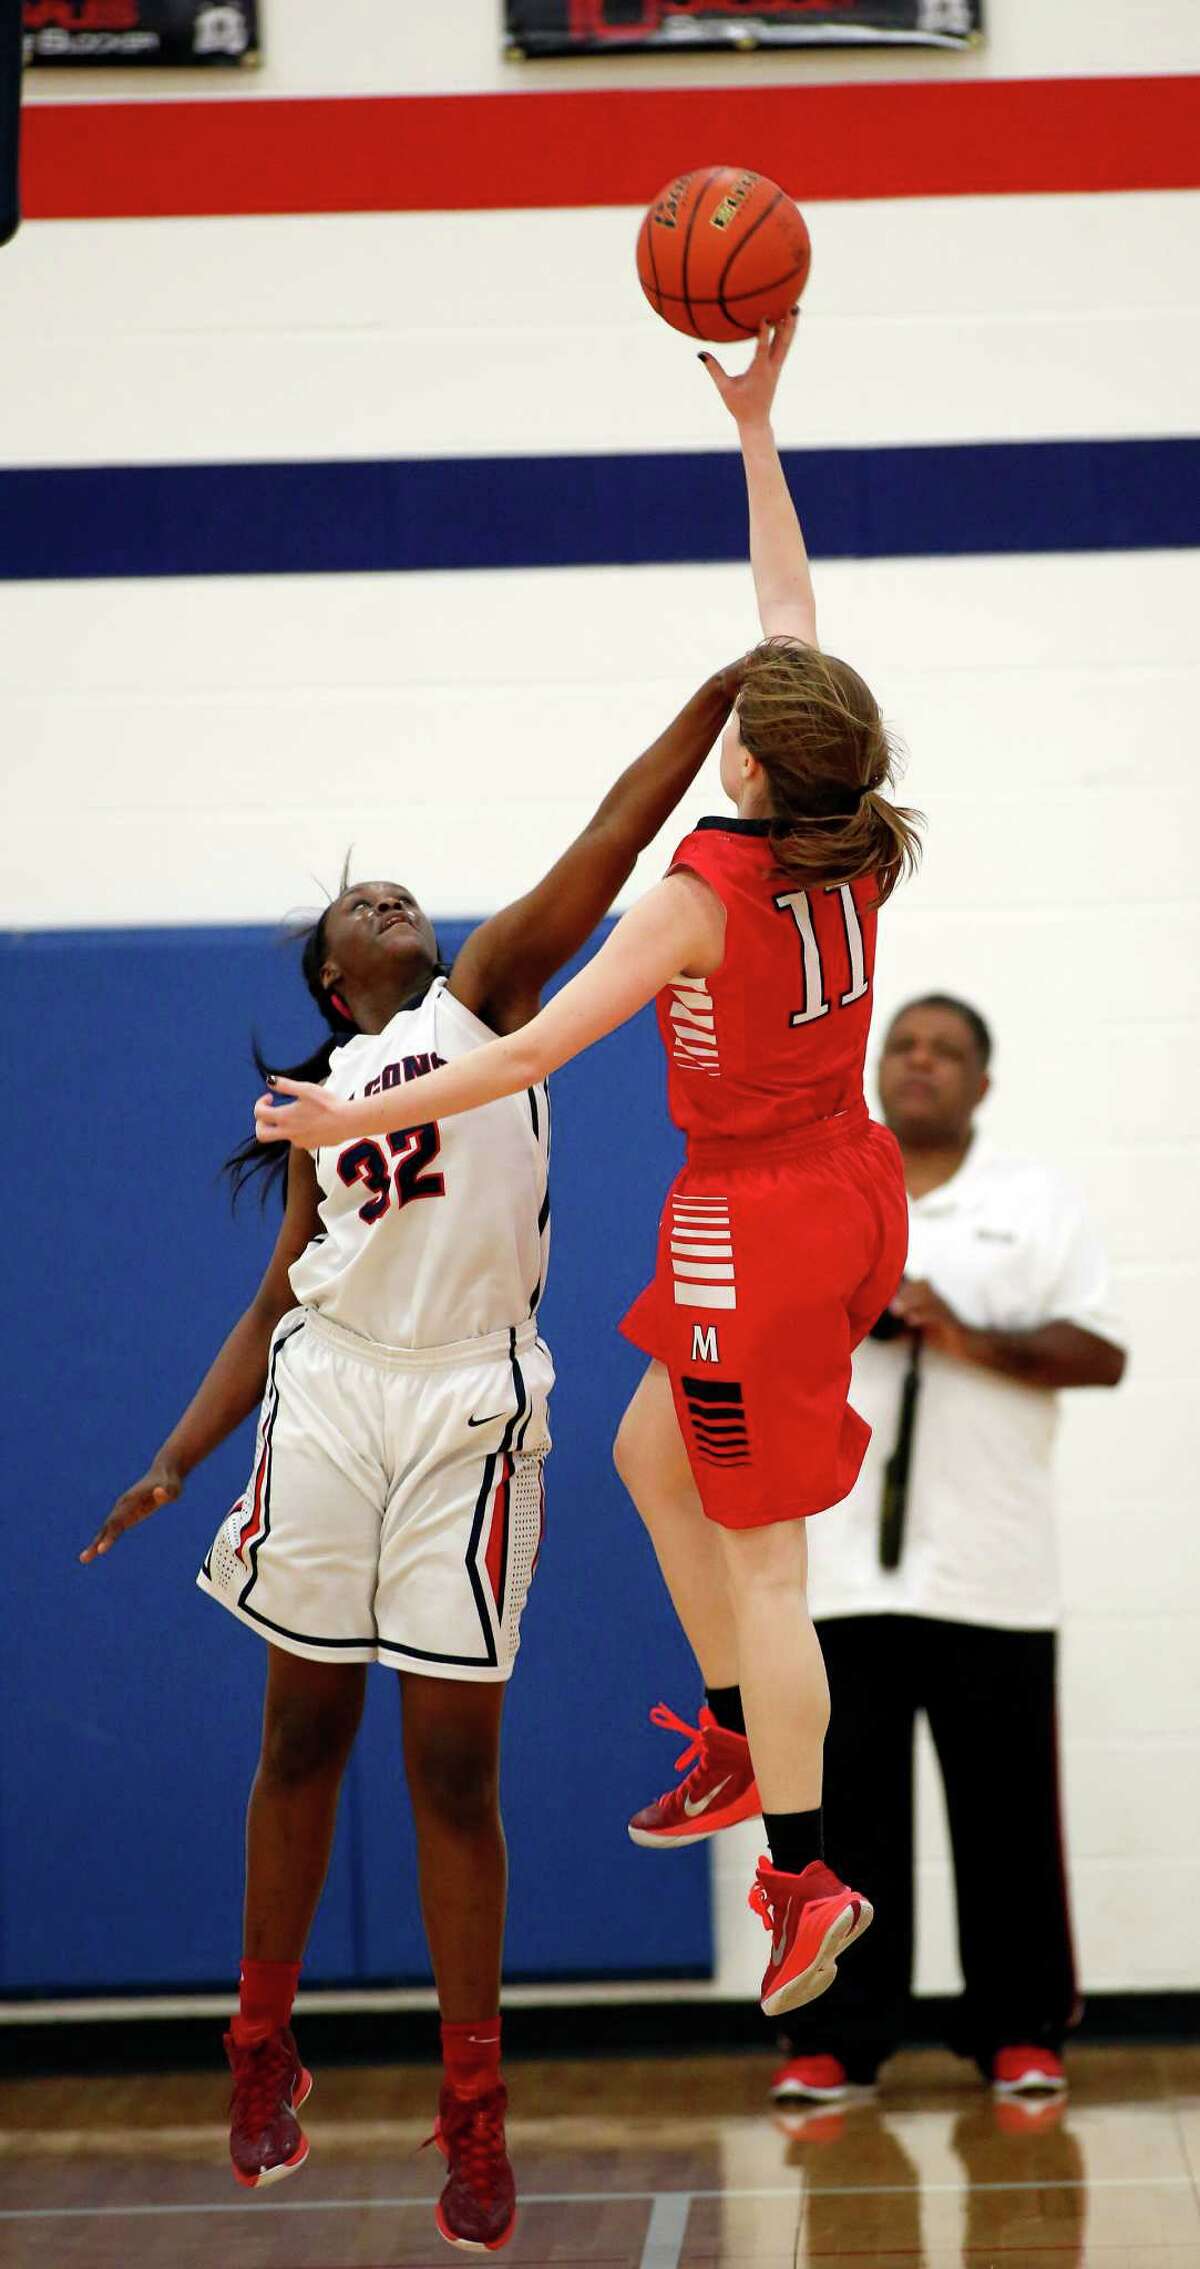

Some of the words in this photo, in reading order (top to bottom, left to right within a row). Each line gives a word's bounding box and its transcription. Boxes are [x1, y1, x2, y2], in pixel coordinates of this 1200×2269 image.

[773, 881, 869, 1028] 11
[336, 1119, 446, 1225] 32
[691, 1323, 720, 1363] M
